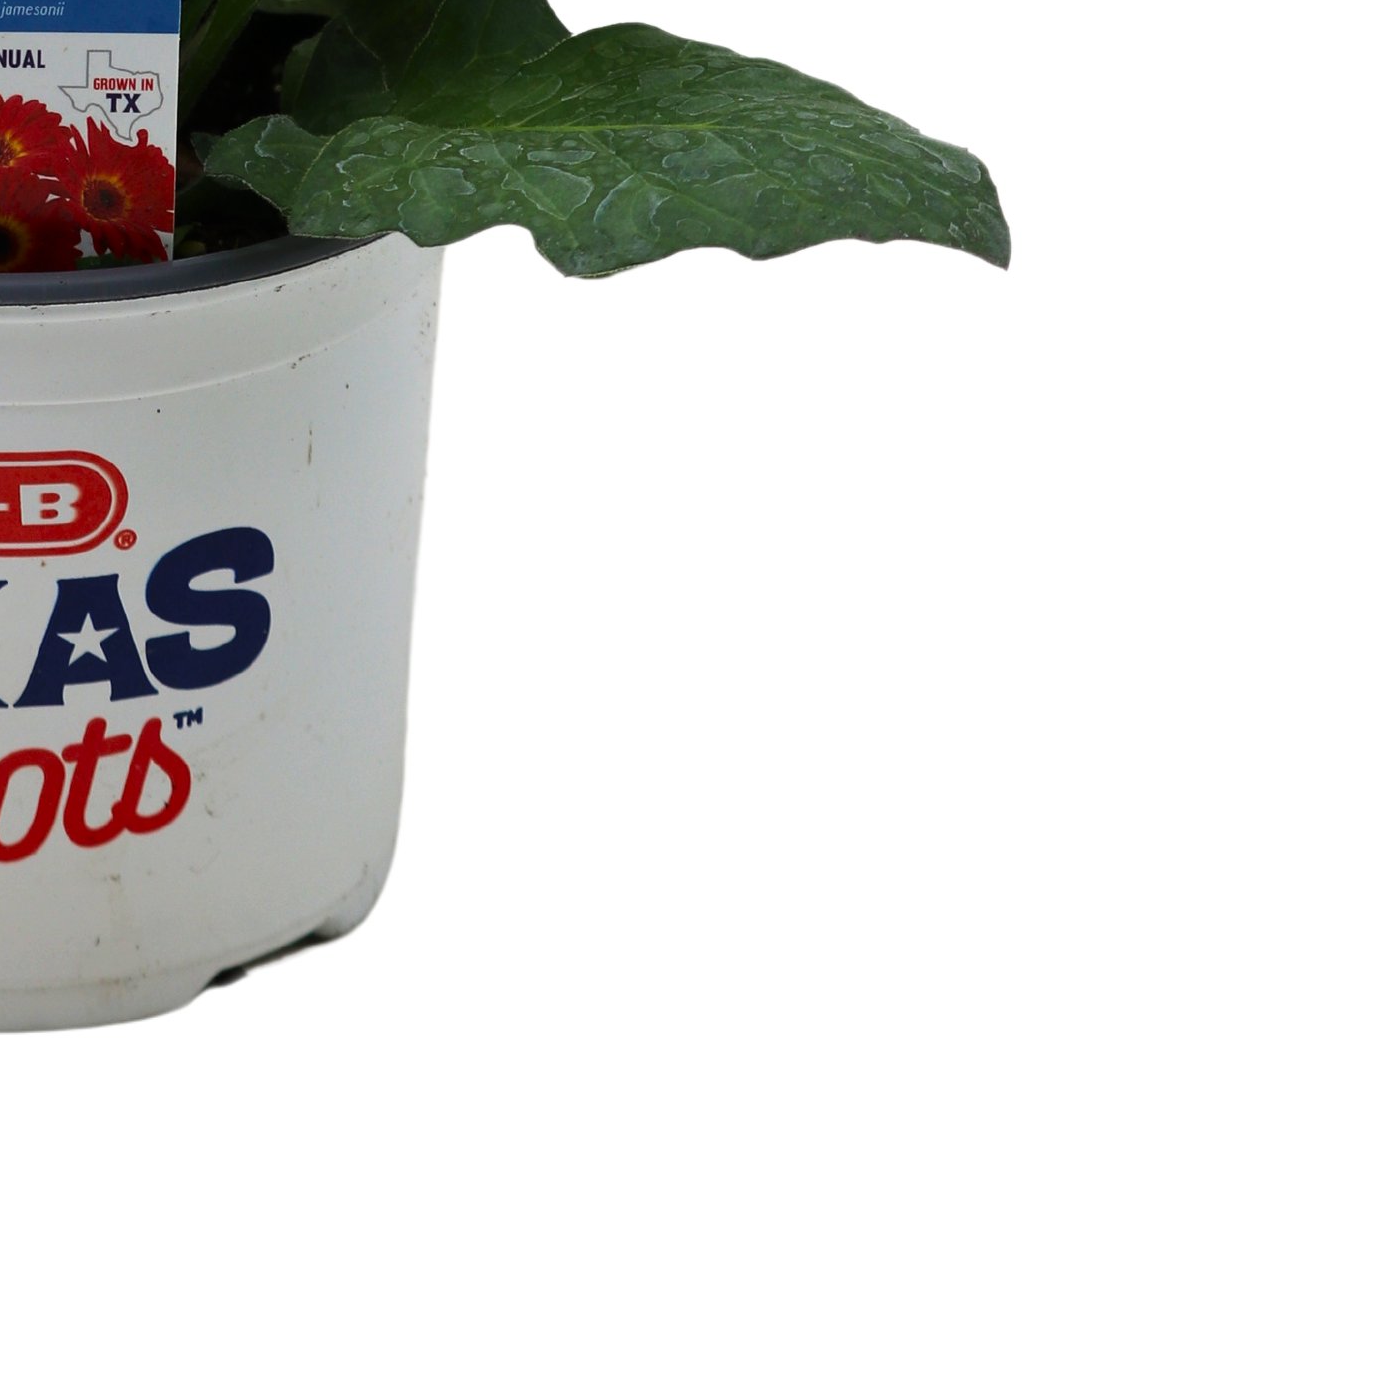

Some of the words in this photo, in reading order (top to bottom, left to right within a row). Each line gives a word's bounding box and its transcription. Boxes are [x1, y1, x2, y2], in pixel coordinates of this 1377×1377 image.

[0, 1, 65, 19] jamesonii
[93, 77, 136, 91] GROWN
[140, 78, 154, 91] IN
[106, 93, 141, 114] TX
